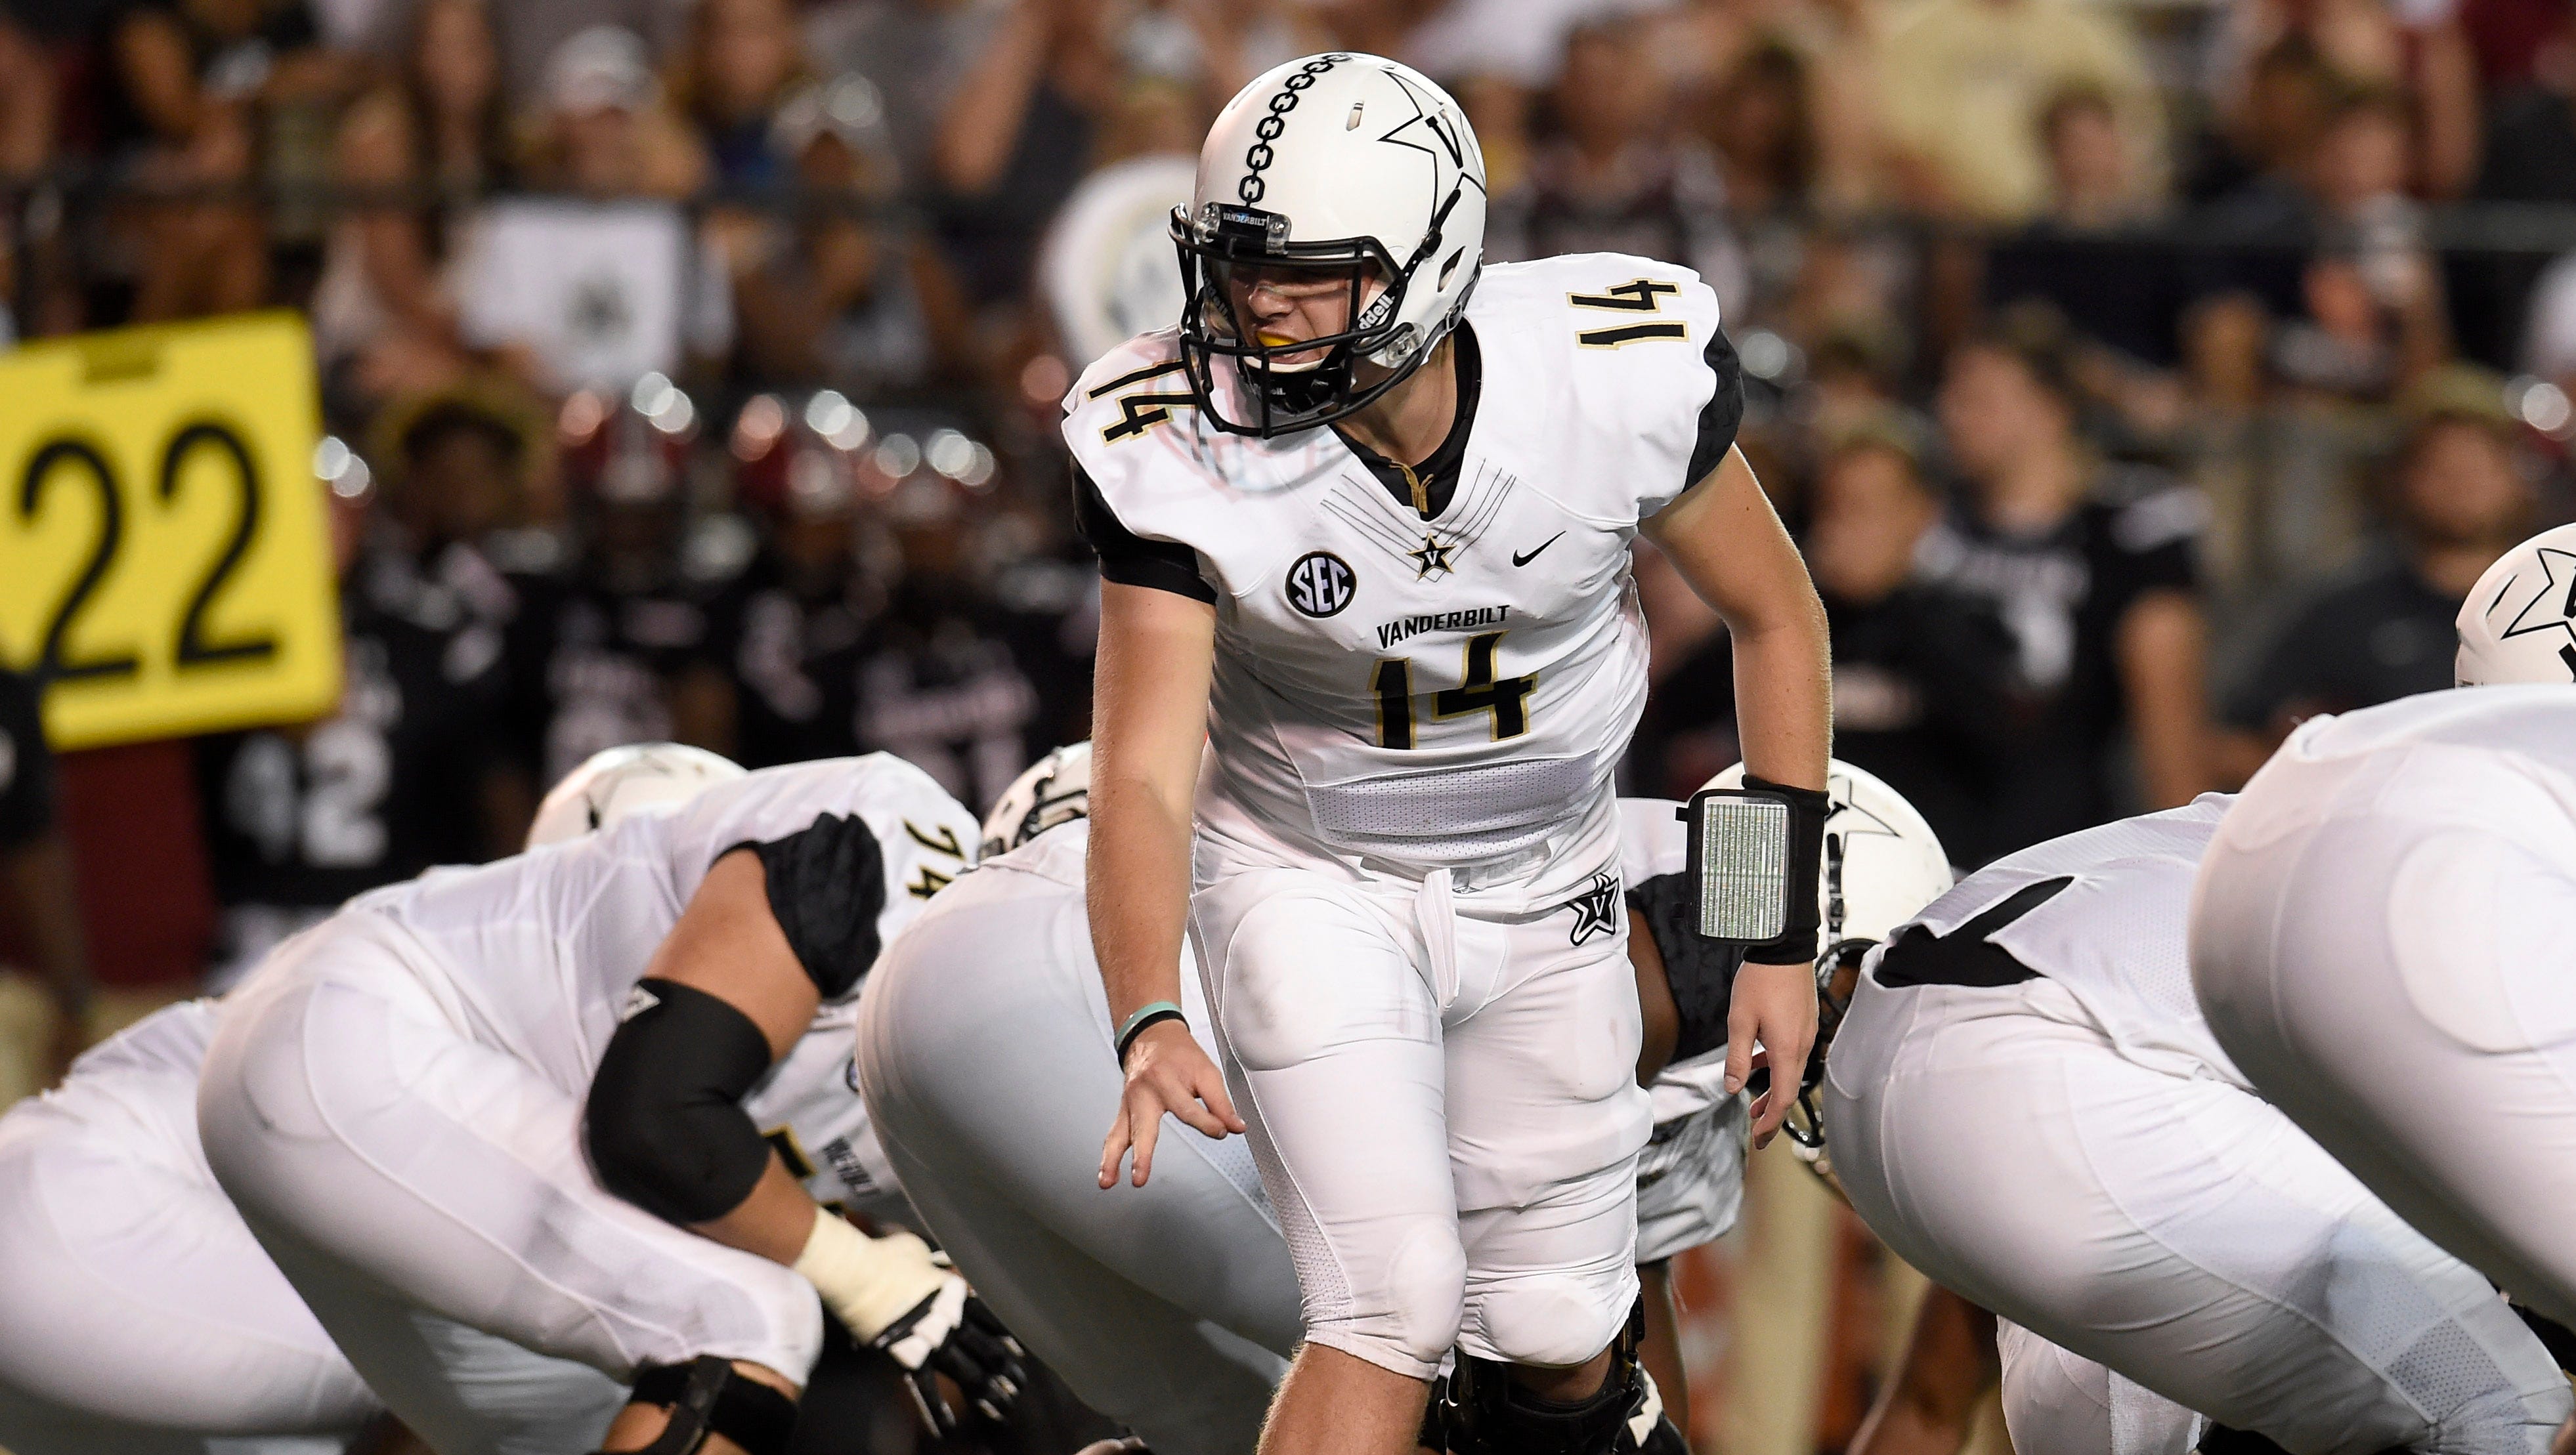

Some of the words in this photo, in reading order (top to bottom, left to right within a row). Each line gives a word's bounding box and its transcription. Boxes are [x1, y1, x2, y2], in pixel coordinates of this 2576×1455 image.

[1222, 211, 1266, 226] VANDERBILT
[1566, 278, 1690, 350] 14
[1084, 359, 1201, 448] 14
[17, 419, 281, 686] 22
[1291, 556, 1350, 613] SEC
[1377, 604, 1511, 649] VANDERBILT
[1367, 629, 1539, 750] 14
[1591, 893, 1607, 917] V
